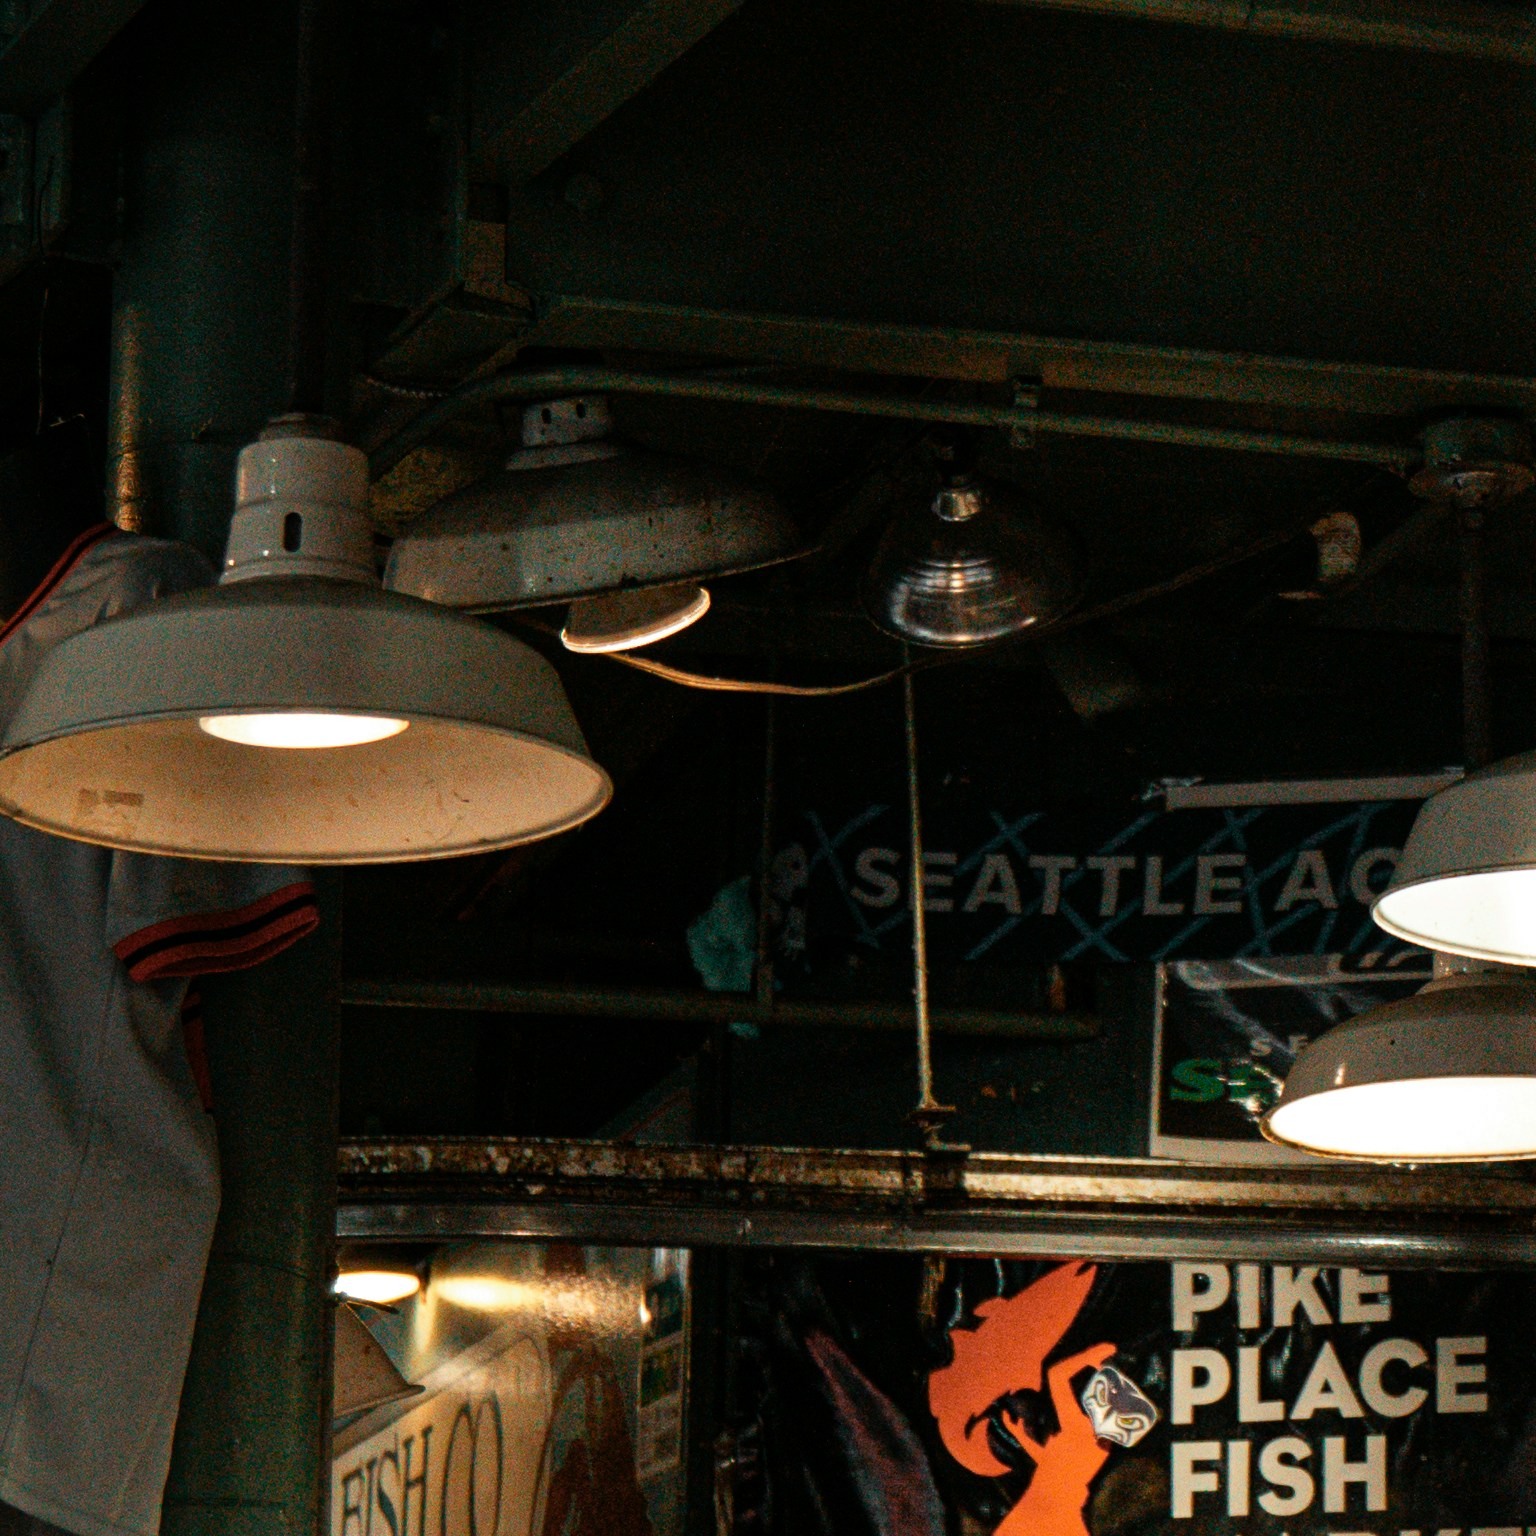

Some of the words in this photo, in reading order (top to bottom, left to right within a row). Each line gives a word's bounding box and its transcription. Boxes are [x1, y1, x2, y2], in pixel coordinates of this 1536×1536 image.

[850, 845, 1247, 917] SEATTLE
[1171, 1263, 1392, 1333] PIKE
[1171, 1335, 1488, 1426] PLACE
[1171, 1434, 1388, 1520] FISH
